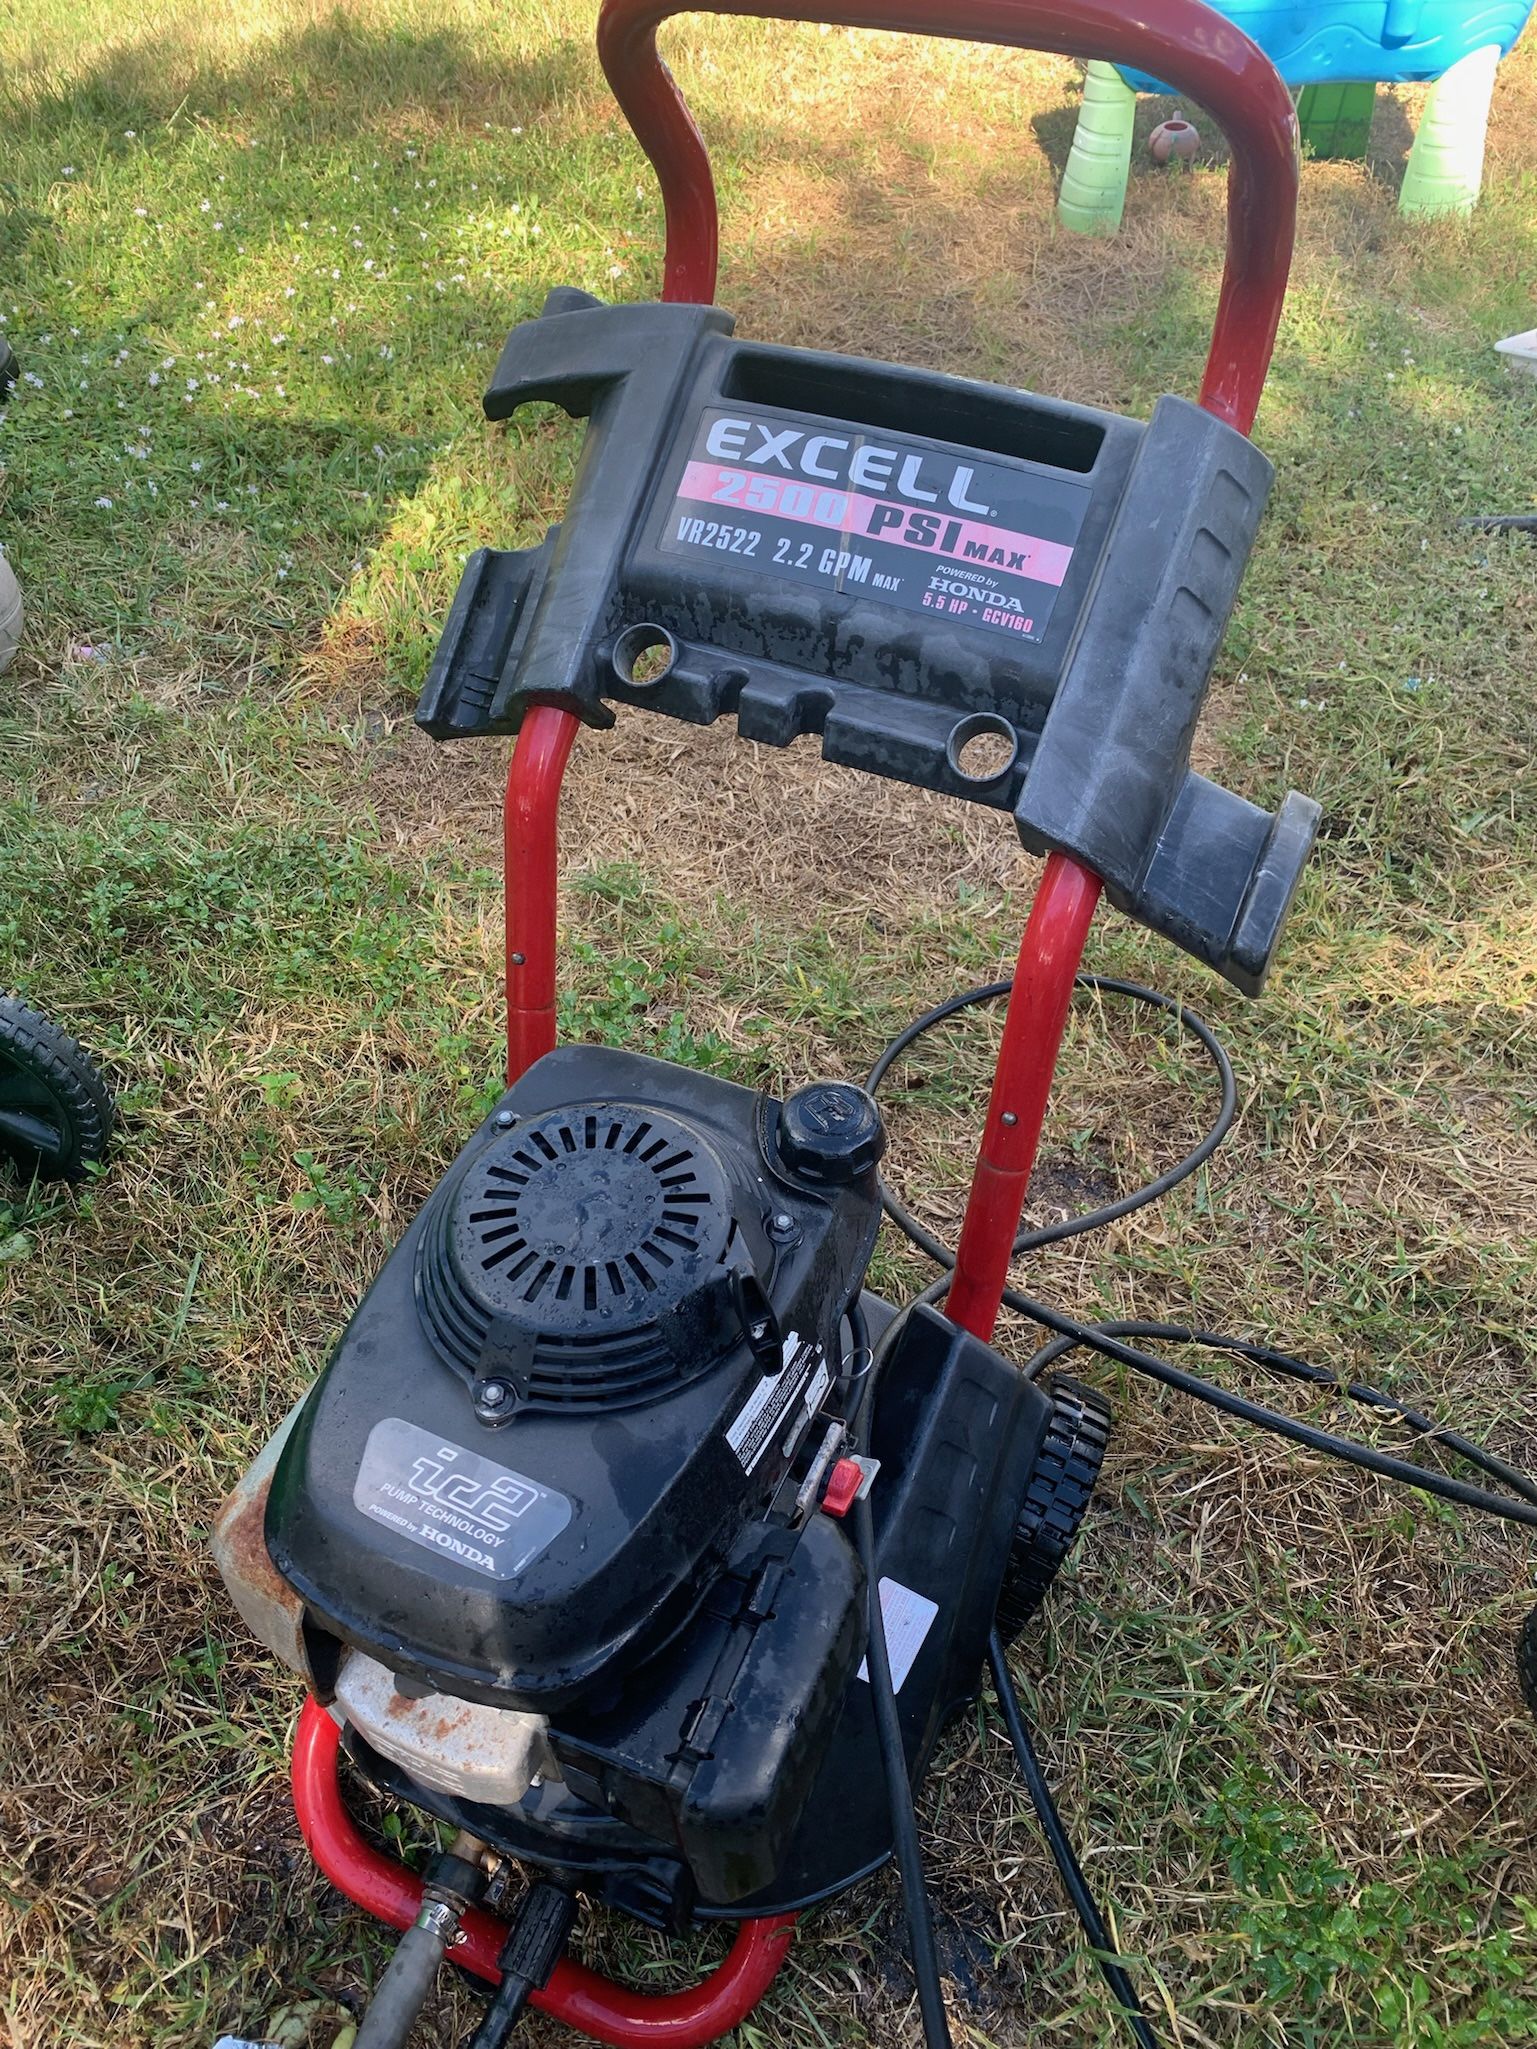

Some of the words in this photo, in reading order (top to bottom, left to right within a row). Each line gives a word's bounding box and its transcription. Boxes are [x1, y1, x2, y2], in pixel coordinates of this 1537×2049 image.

[706, 418, 990, 516] EXCELL
[711, 471, 848, 526] 2500
[866, 504, 963, 553] PSI
[676, 517, 762, 557] VR2522
[772, 538, 814, 569] 2.2
[818, 548, 873, 584] GPM
[927, 576, 1025, 613] HONDA
[935, 564, 986, 583] POWERED
[985, 575, 999, 588] by
[922, 592, 947, 610] 5.5
[948, 599, 969, 615] HP
[981, 609, 1034, 633] GCV160
[368, 1503, 410, 1527] POWERED
[406, 1519, 418, 1533] by
[380, 1482, 419, 1506] PUMP
[418, 1500, 506, 1549] TECHNOLOGY
[419, 1524, 496, 1571] HONDA
